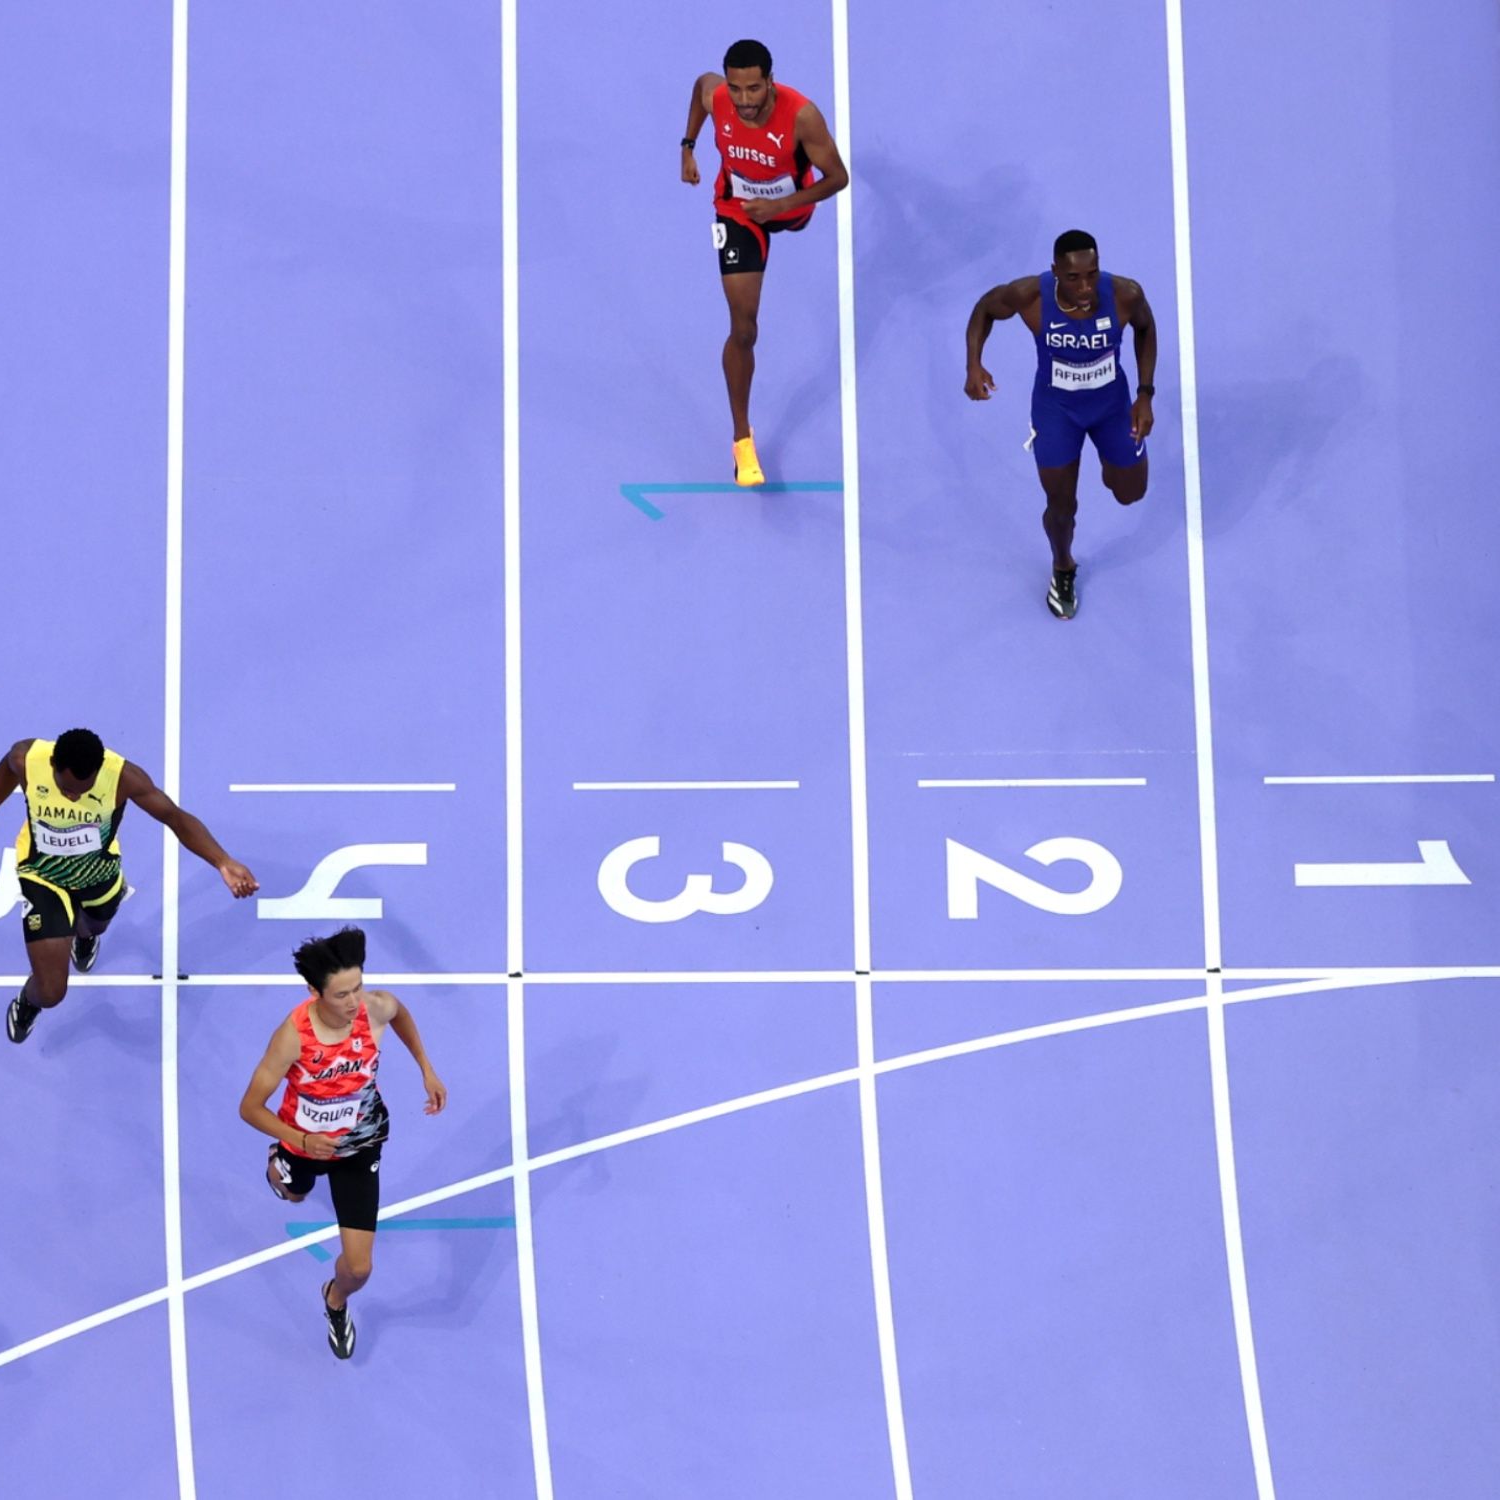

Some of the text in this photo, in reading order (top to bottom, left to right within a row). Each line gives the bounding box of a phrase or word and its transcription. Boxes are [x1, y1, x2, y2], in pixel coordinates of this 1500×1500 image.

[728, 145, 776, 168] SUISSE
[1046, 333, 1112, 349] ISRAEL
[1055, 363, 1112, 383] AFRIFAH
[36, 804, 103, 824] JAMAICA
[42, 833, 93, 848] LEVELL
[1294, 840, 1472, 887] 1
[257, 842, 428, 919] 4
[597, 835, 774, 923] 3
[946, 836, 1124, 920] 2
[312, 1059, 363, 1081] JAPAN
[302, 1103, 354, 1123] UZAWA
